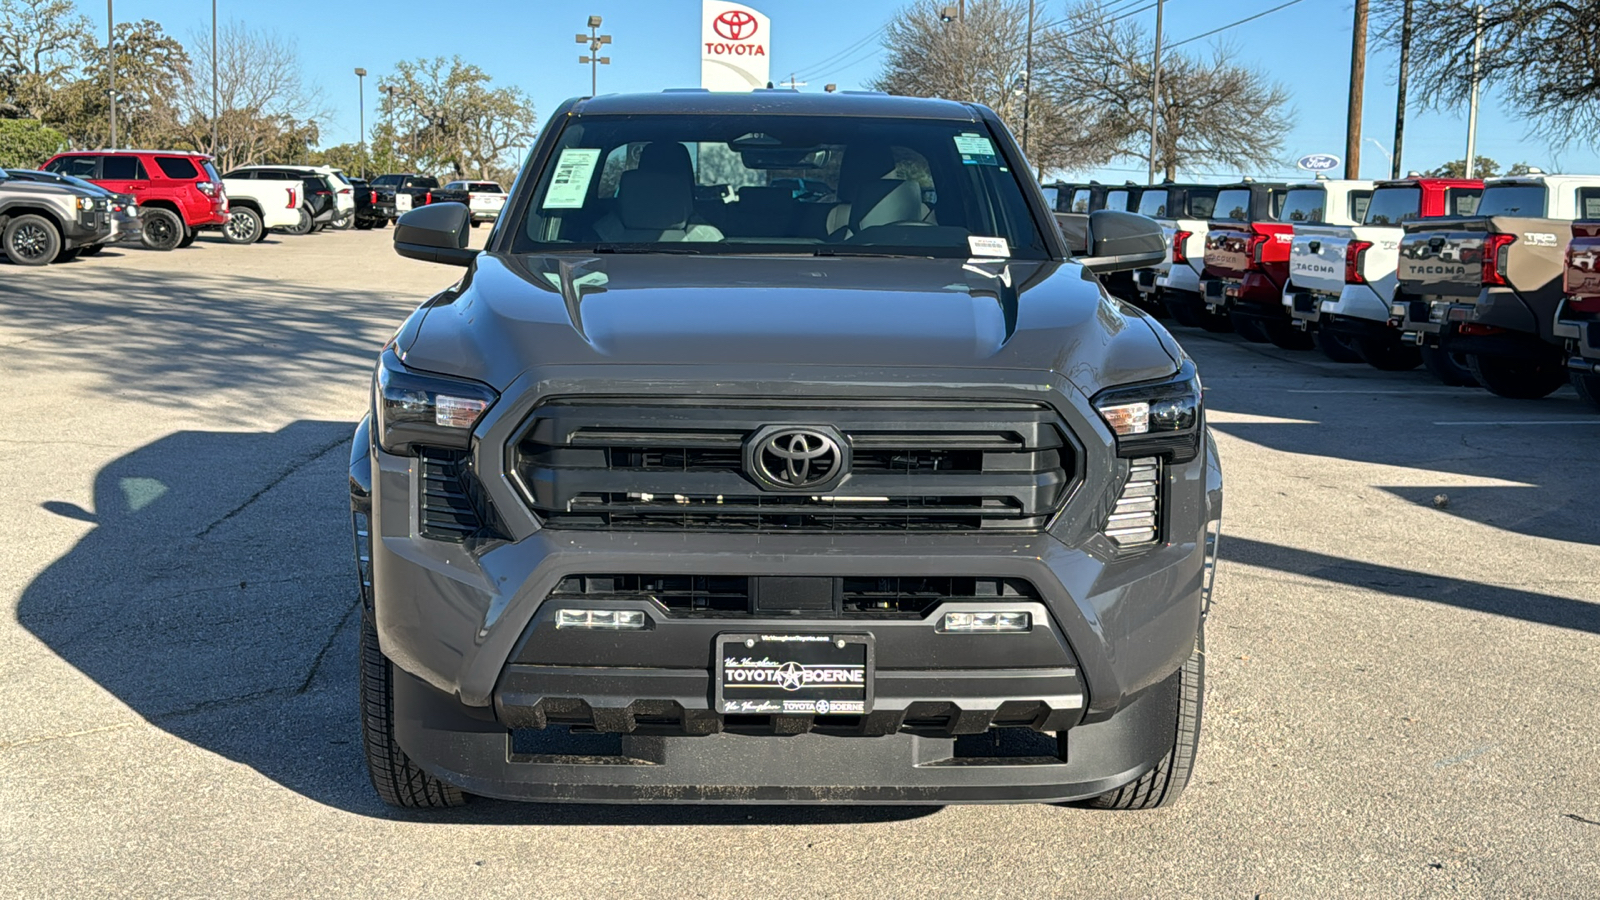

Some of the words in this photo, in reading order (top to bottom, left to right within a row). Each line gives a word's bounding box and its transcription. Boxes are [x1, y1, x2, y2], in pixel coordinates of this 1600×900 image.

[705, 43, 765, 56] TOYOTA
[1306, 156, 1332, 168] Ford
[1524, 233, 1557, 243] TRD
[1296, 263, 1335, 274] TACOMA
[1409, 266, 1466, 275] TACOMA
[725, 669, 783, 682] TOYOTA
[802, 670, 865, 682] BOERNE
[783, 703, 815, 711] TOYOTA
[829, 703, 865, 711] BOERNE
